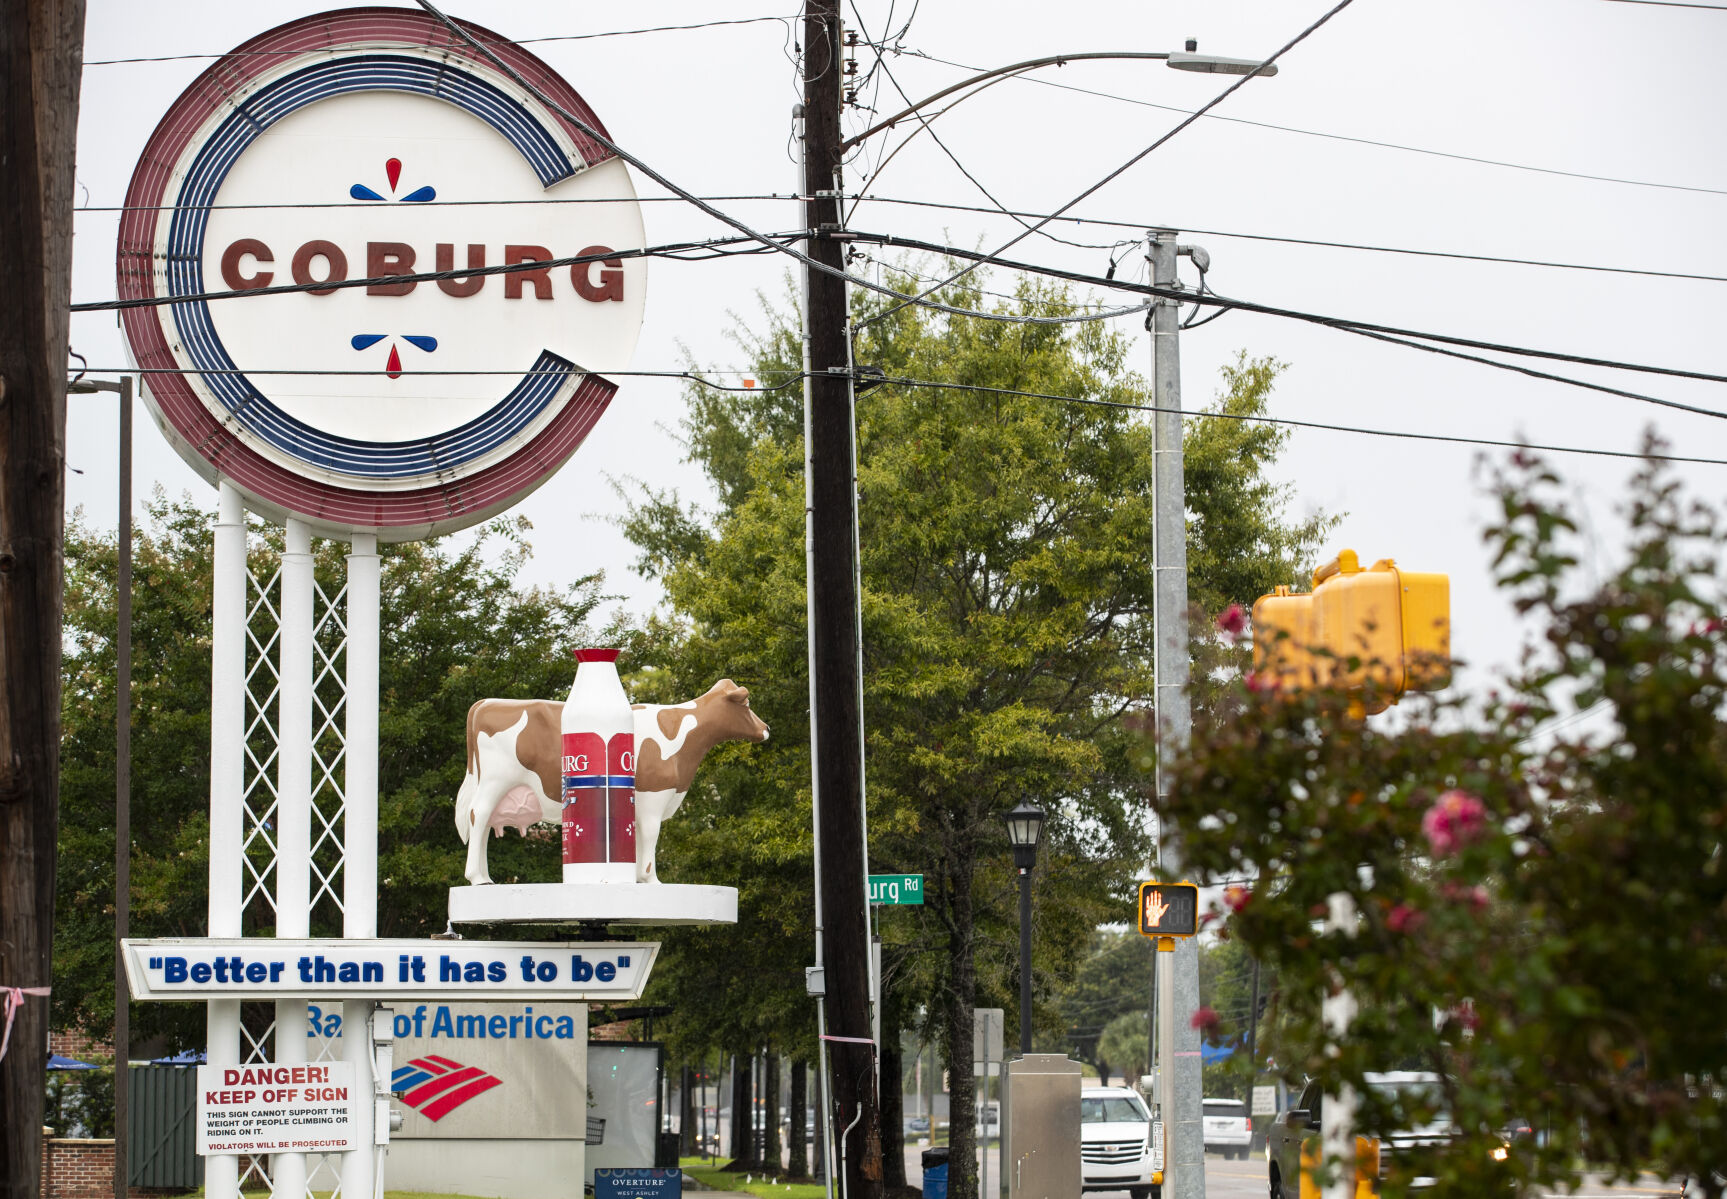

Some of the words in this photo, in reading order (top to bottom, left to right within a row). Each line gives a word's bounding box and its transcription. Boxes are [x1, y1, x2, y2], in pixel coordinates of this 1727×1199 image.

[220, 238, 624, 302] COBURG
[562, 755, 589, 772] URG
[868, 882, 898, 903] urg
[905, 878, 918, 891] Rd
[149, 956, 285, 983] "Better
[297, 956, 383, 983] than
[399, 955, 425, 983] it
[440, 955, 506, 983] has
[520, 957, 557, 983] to
[572, 955, 630, 982] be"
[308, 1006, 342, 1037] Ba
[393, 1006, 427, 1038] of
[432, 1006, 574, 1039] America
[225, 1067, 328, 1085] DANGER!
[206, 1091, 256, 1104] KEEP
[263, 1089, 298, 1103] OFF
[304, 1088, 348, 1101] SIGN
